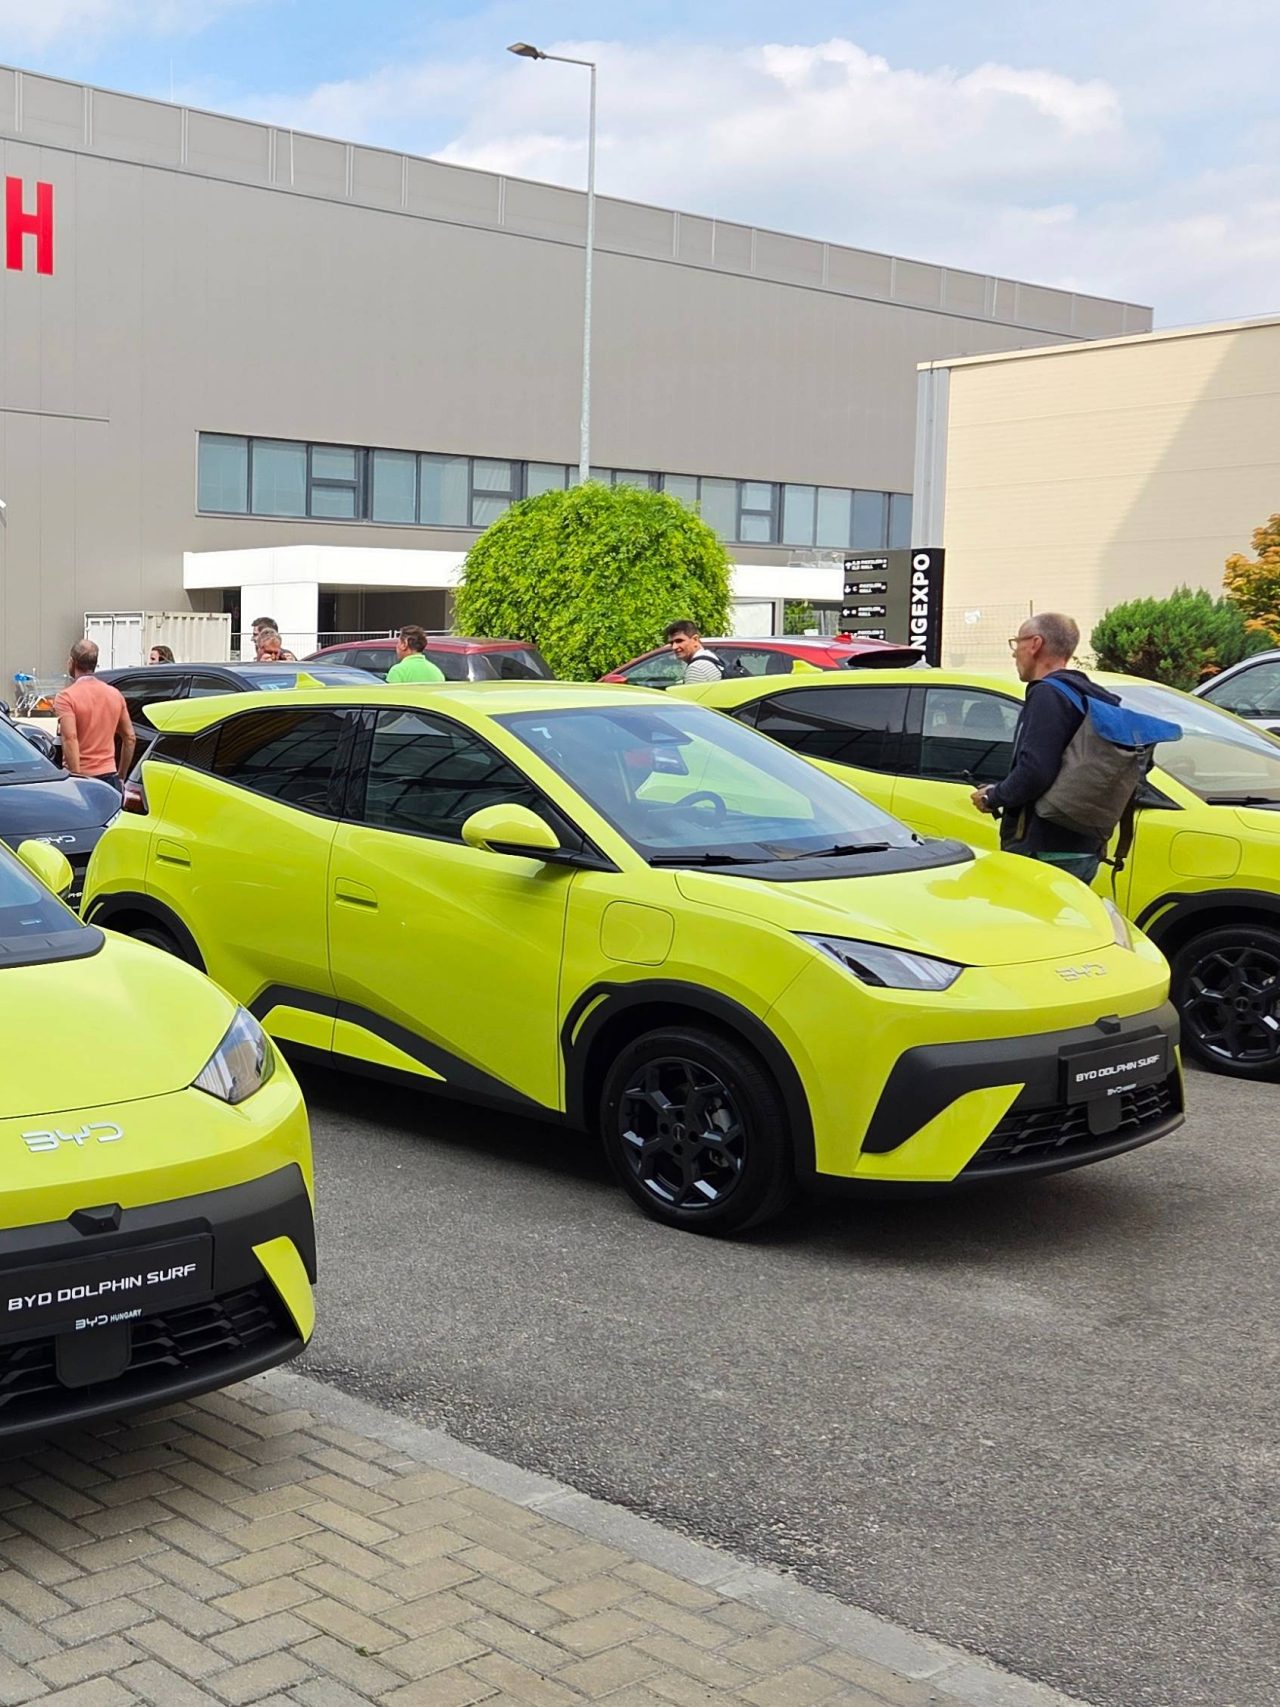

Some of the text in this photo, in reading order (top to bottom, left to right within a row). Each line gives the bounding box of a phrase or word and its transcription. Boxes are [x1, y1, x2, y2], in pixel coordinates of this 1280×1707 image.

[6, 176, 54, 276] H
[910, 553, 931, 652] NGEXPO
[531, 726, 553, 739] 7
[1076, 1055, 1160, 1082] BYD DOLPHIN SURF
[20, 1122, 125, 1153] BYD
[7, 1263, 197, 1312] BYD DOLPHIN SURF
[75, 1308, 143, 1331] BYD HUNGARY
